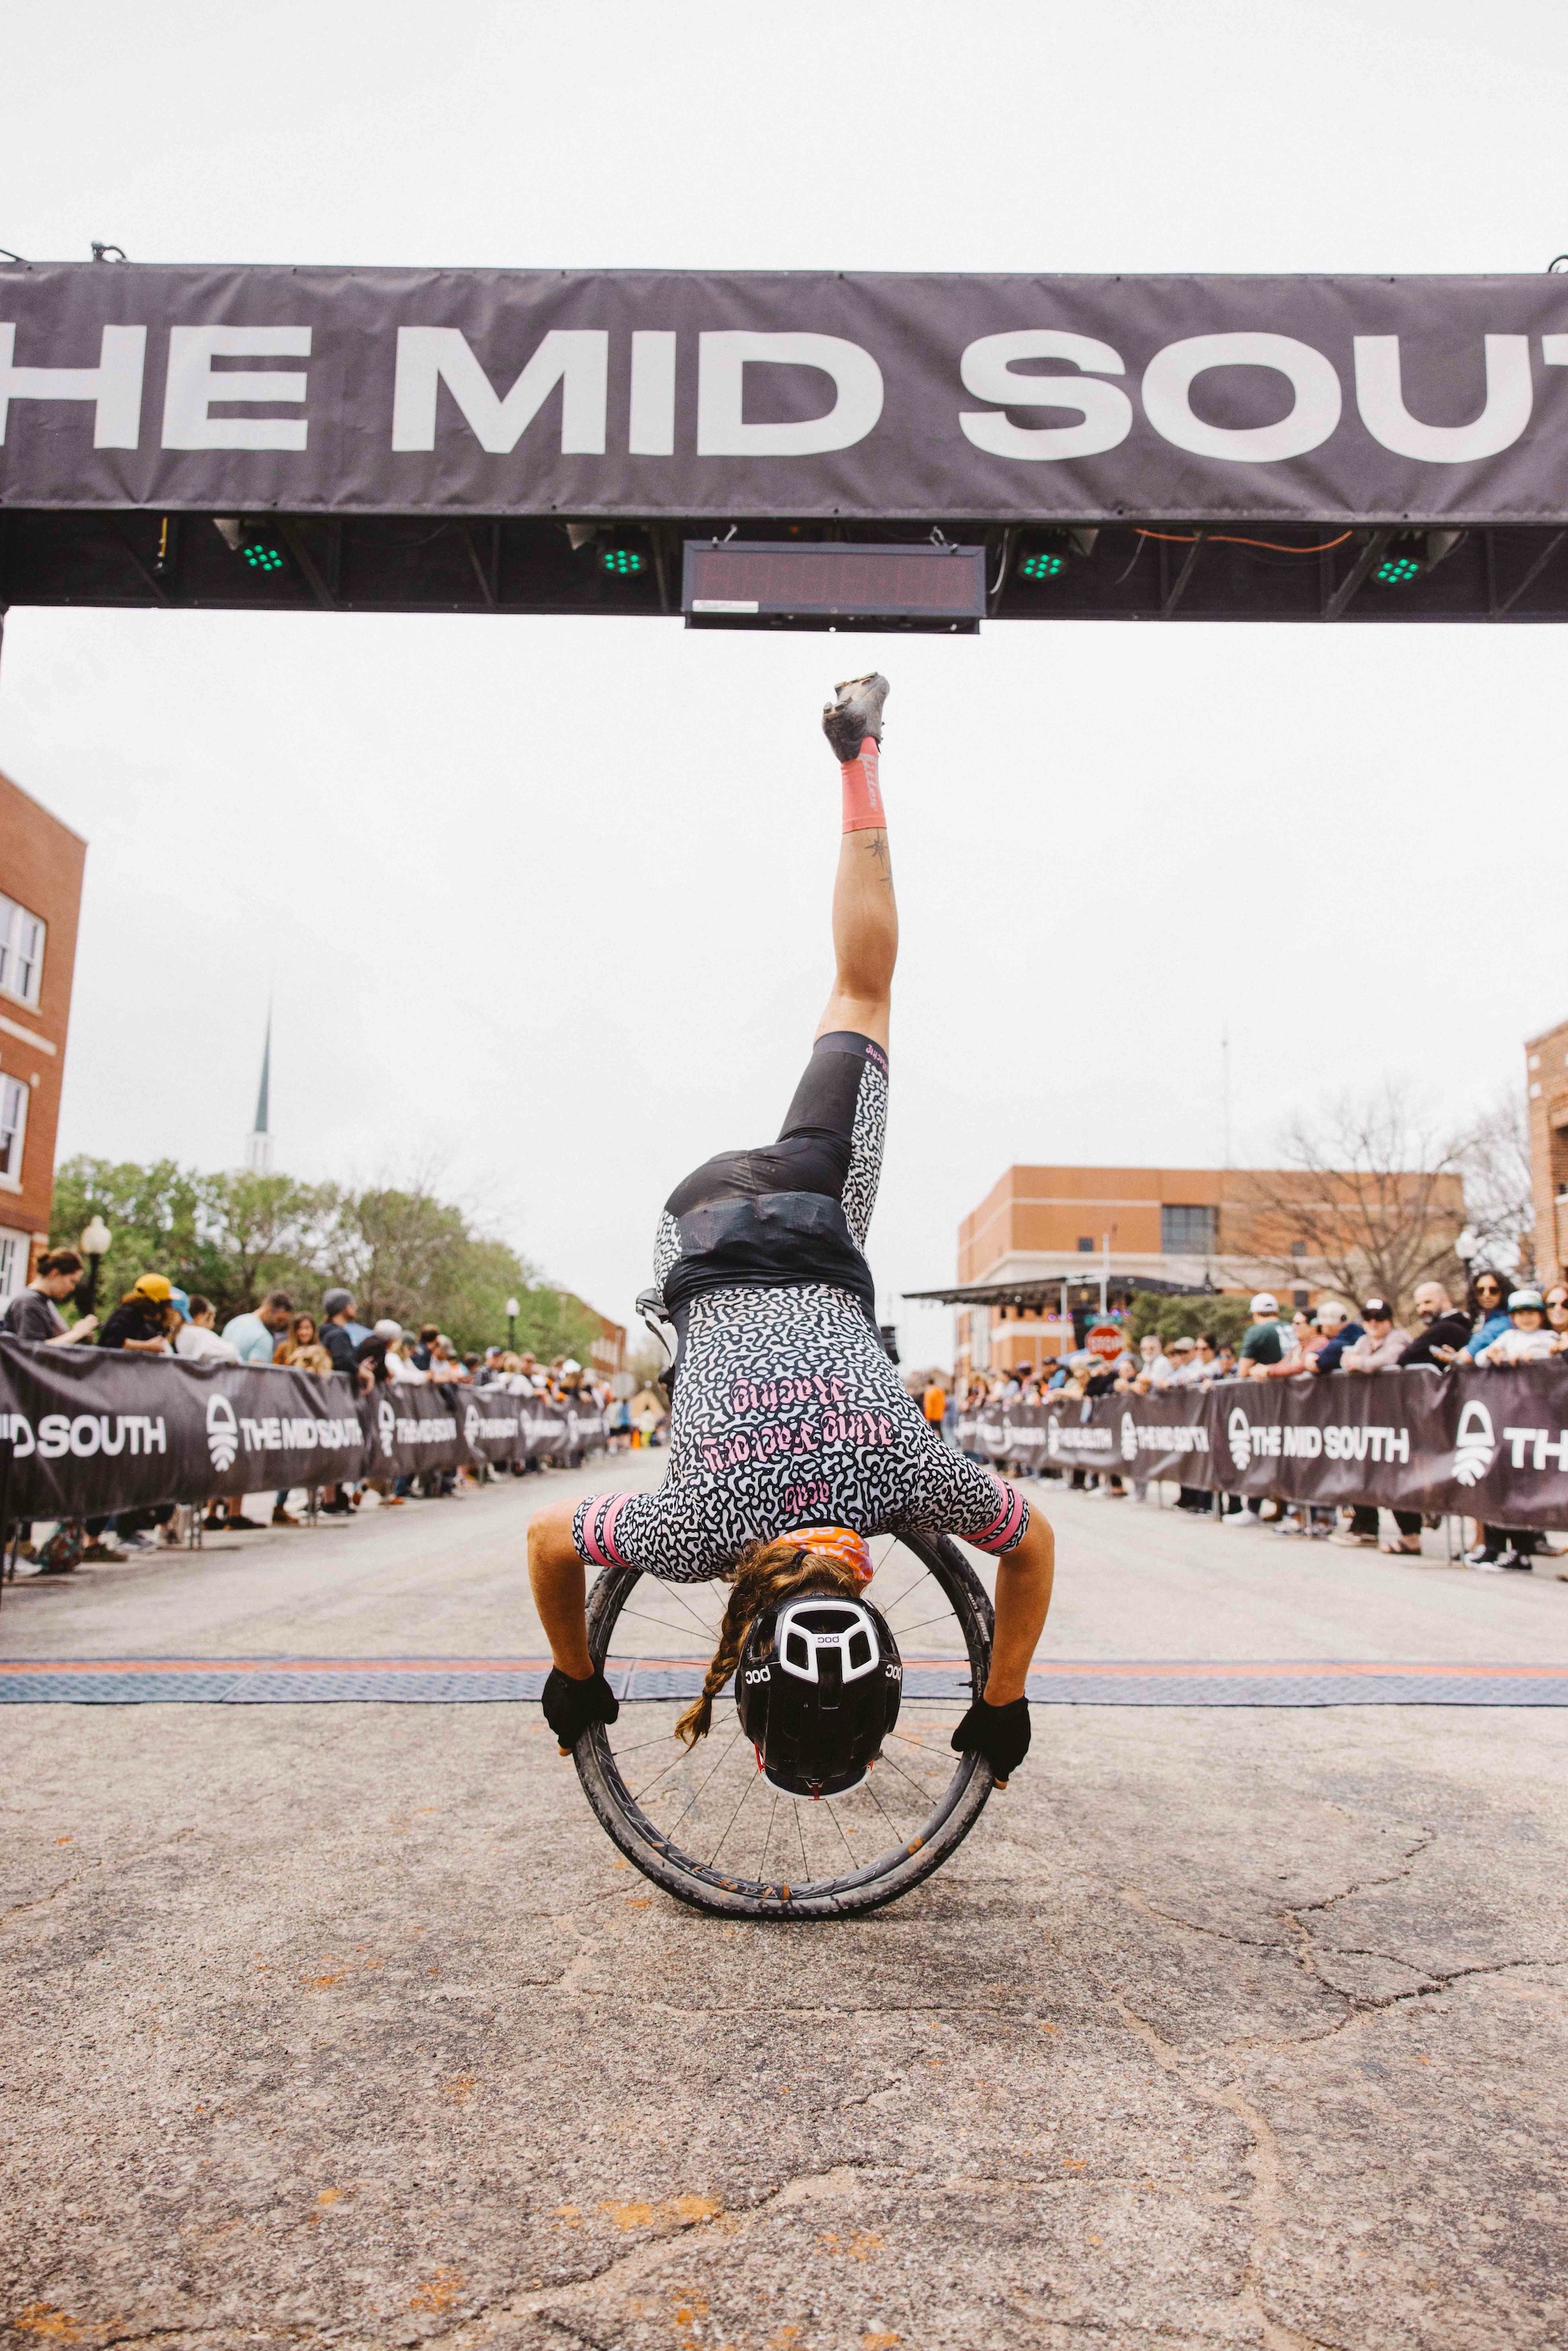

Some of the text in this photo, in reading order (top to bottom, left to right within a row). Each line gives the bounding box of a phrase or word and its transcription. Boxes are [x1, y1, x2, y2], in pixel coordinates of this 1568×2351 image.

[391, 326, 884, 457] MID
[958, 329, 1568, 464] SOU
[731, 1374, 848, 1413] Racing
[37, 1413, 167, 1459] SOUTH
[239, 1417, 283, 1452] THE
[1250, 1425, 1410, 1464] THE MID SOUTH
